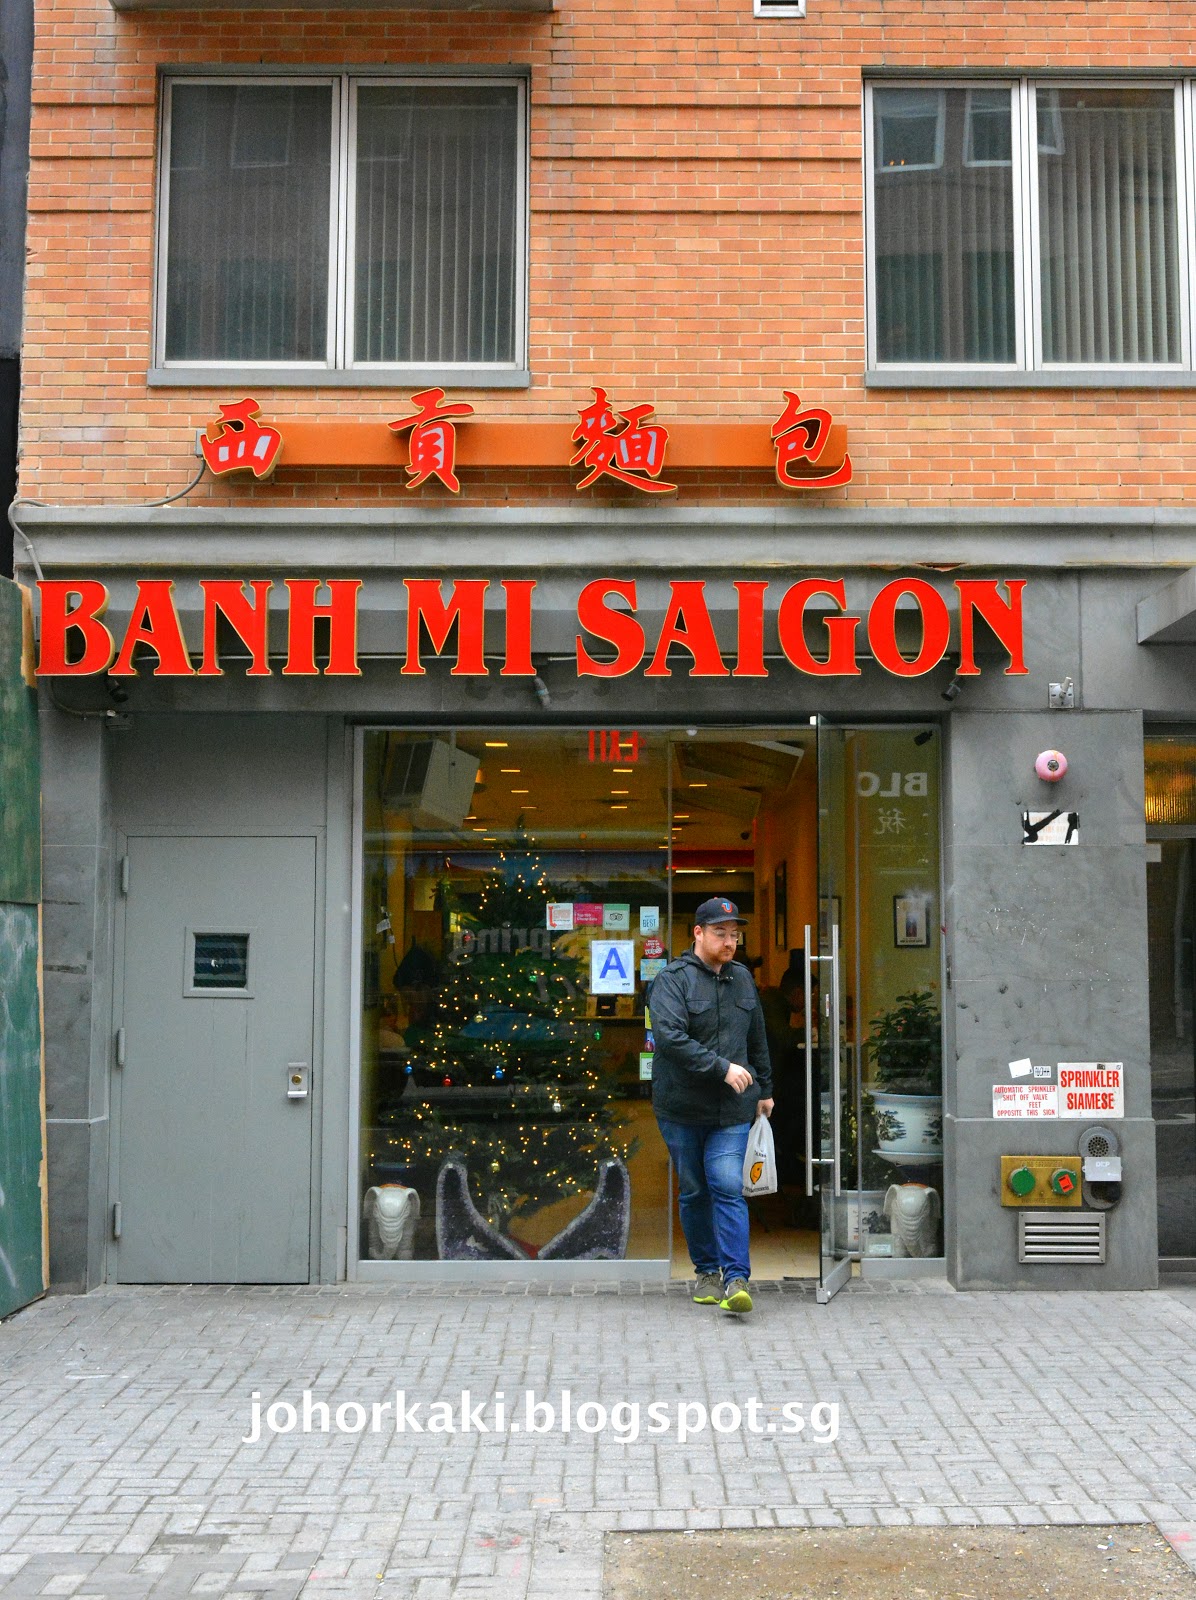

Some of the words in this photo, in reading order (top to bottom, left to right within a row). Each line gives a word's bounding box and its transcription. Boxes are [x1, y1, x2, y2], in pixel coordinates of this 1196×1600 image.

[200, 386, 852, 493] 西貢麵包
[34, 578, 363, 676] BANH
[400, 578, 538, 676] MI
[576, 577, 1029, 677] SAIGON
[642, 918, 656, 928] BEST
[599, 947, 628, 978] A
[1060, 1070, 1120, 1088] SPRINKLER
[1066, 1092, 1114, 1110] SIAMESE
